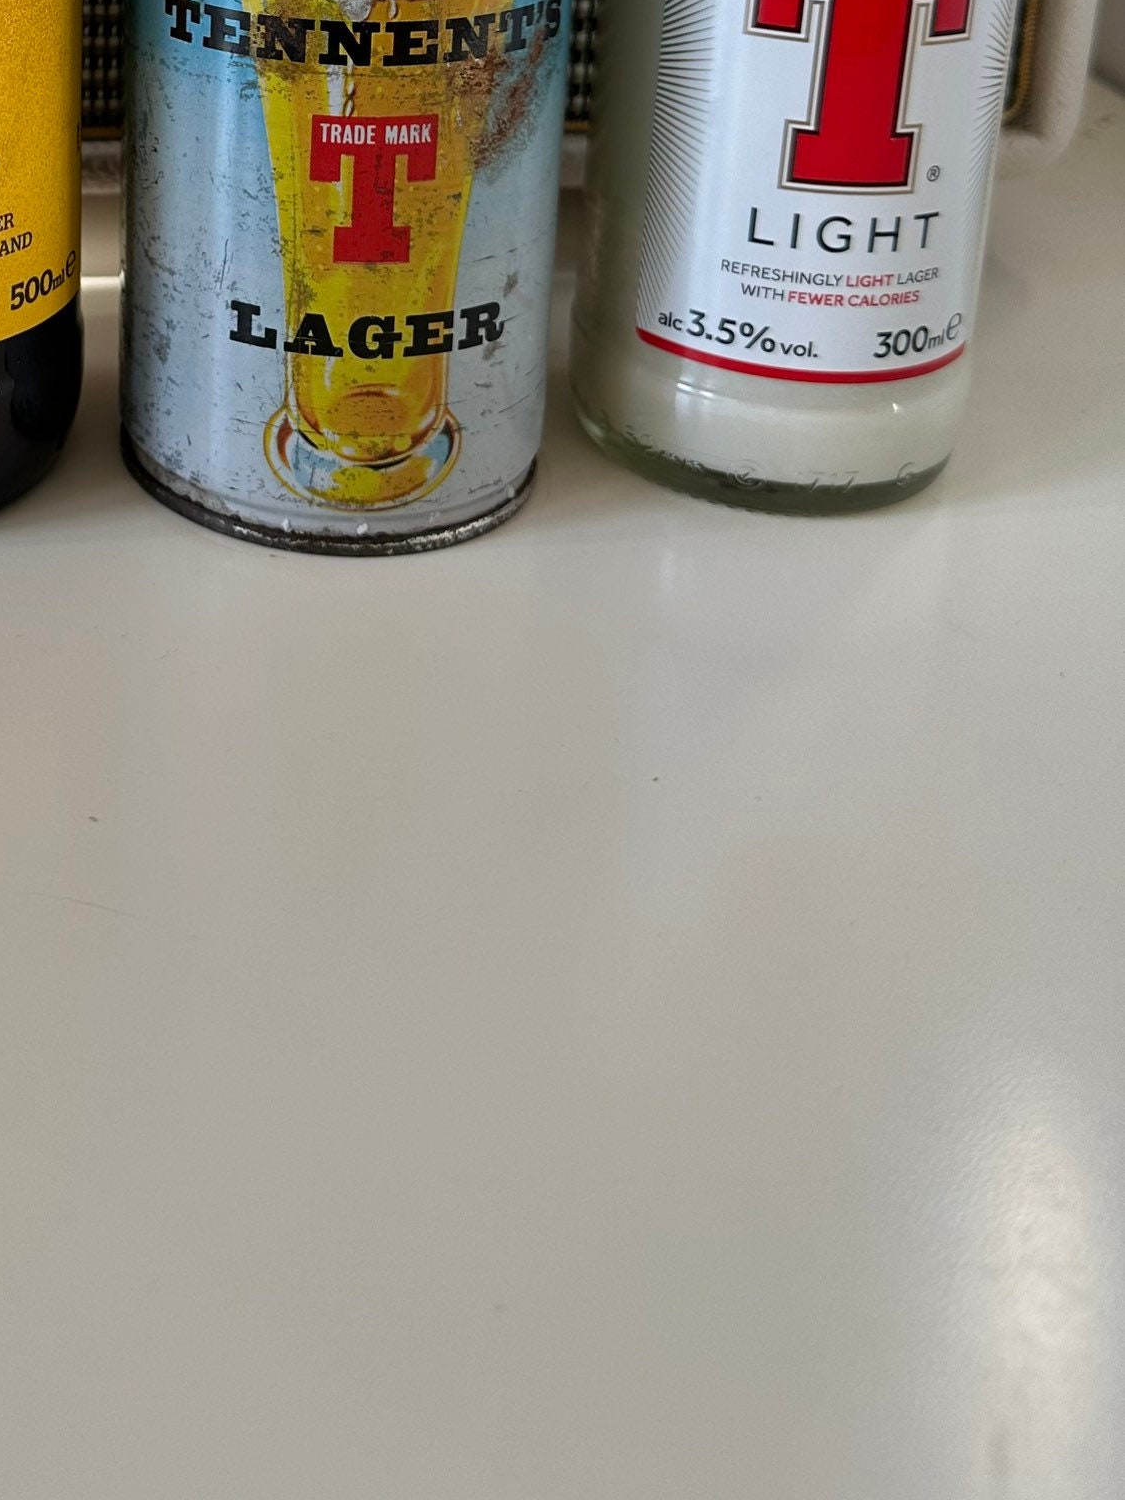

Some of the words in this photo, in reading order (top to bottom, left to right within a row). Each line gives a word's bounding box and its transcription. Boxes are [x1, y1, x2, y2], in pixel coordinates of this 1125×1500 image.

[320, 122, 375, 145] TRADE
[385, 122, 432, 145] MARK
[309, 114, 438, 263] T
[747, 207, 940, 253] LIGHT
[720, 259, 844, 287] REFRESHINGLY
[845, 274, 894, 288] LIGHT
[897, 267, 939, 285] LAGER
[741, 282, 785, 302] WITH
[787, 291, 844, 306] FEWER
[848, 290, 920, 306] CALORIES
[229, 300, 505, 359] LAGER
[658, 309, 682, 331] alc
[780, 340, 818, 358] vol.
